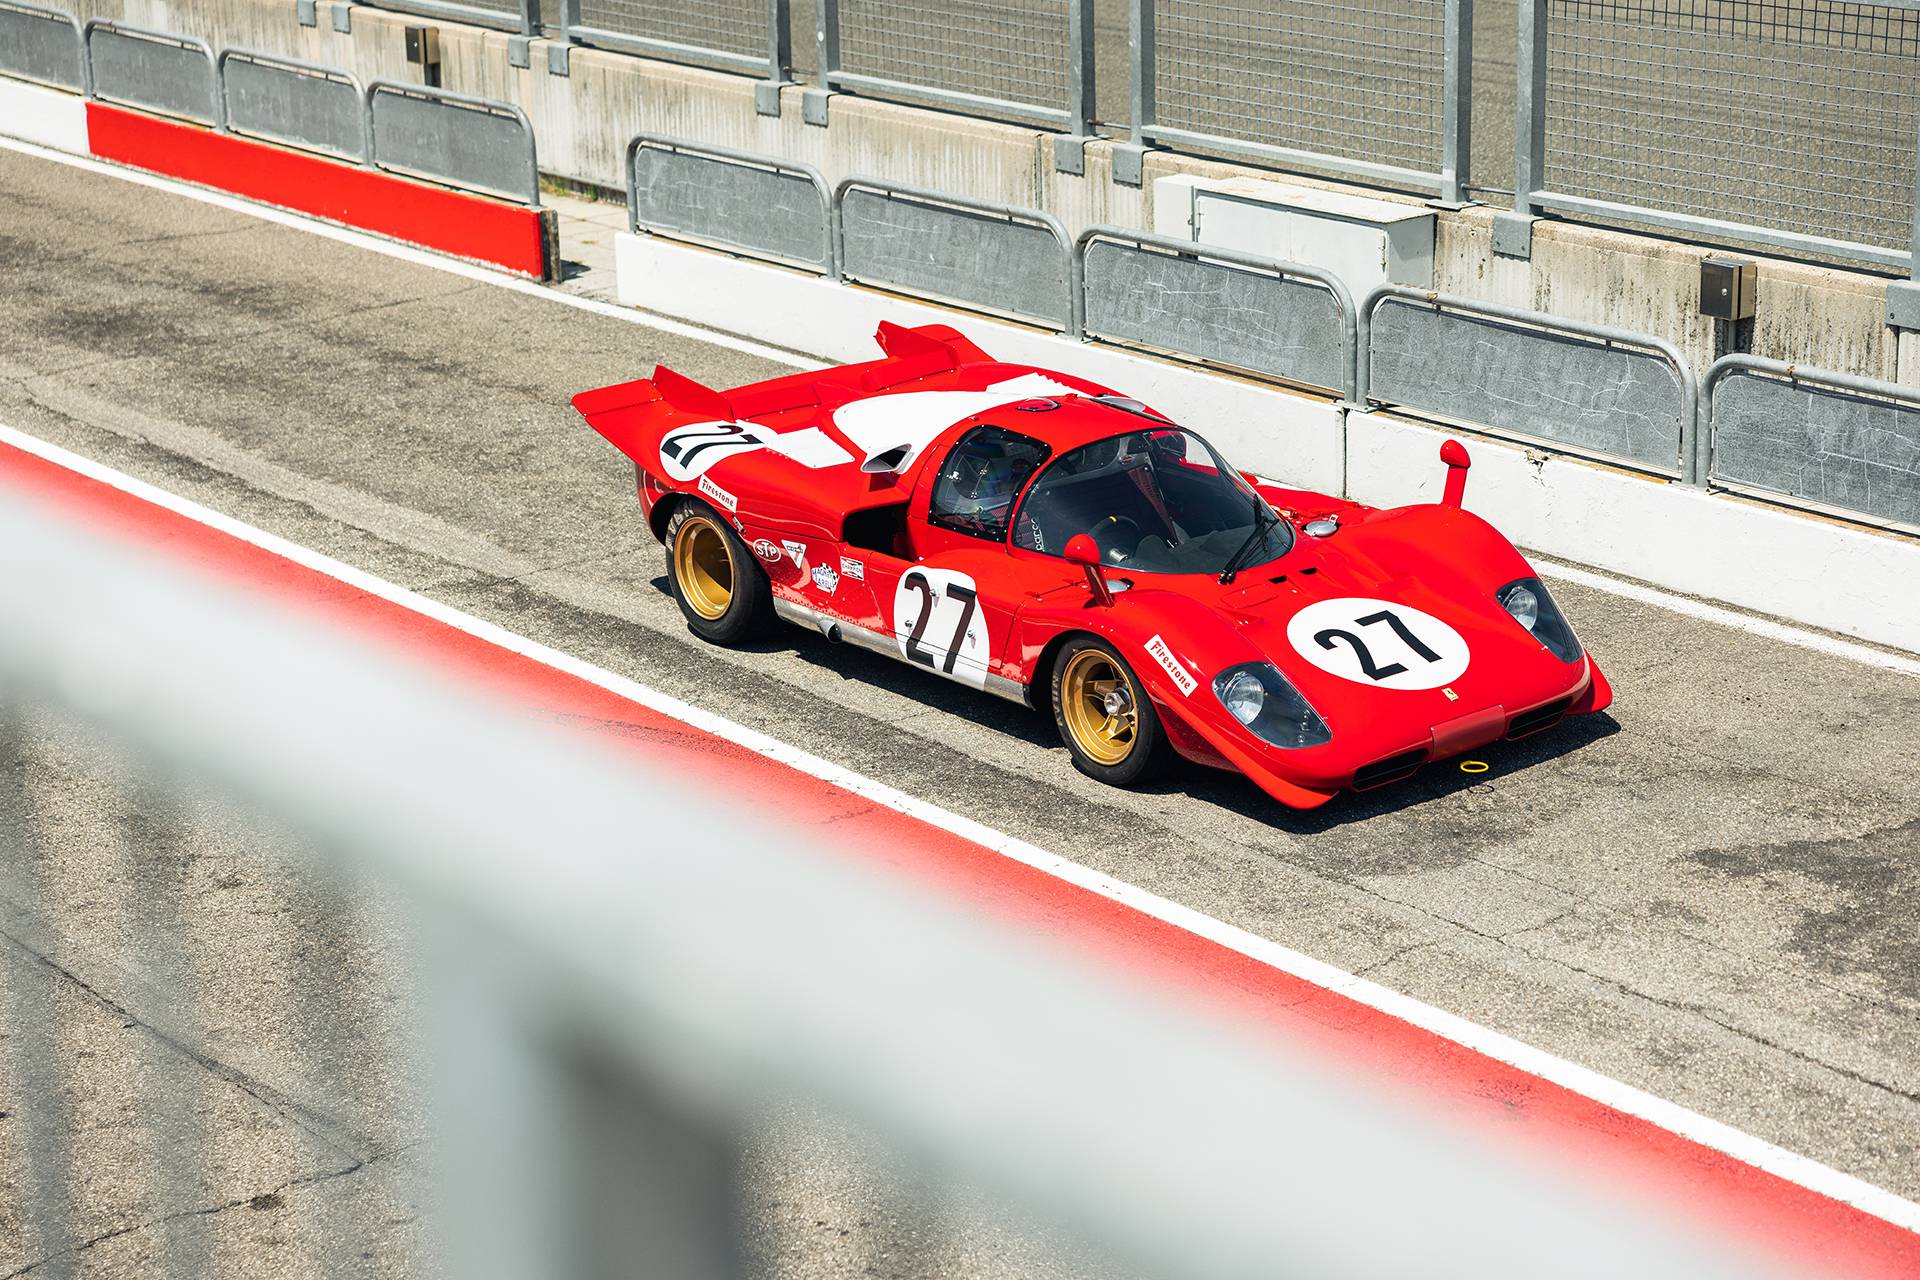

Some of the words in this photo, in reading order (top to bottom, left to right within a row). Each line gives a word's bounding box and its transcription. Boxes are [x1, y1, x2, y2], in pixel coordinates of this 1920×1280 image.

[661, 425, 764, 469] 27
[702, 479, 734, 507] Firestone
[757, 541, 777, 558] STP
[905, 572, 977, 674] 27
[1314, 610, 1443, 681] 27
[1150, 640, 1191, 690] Firestone
